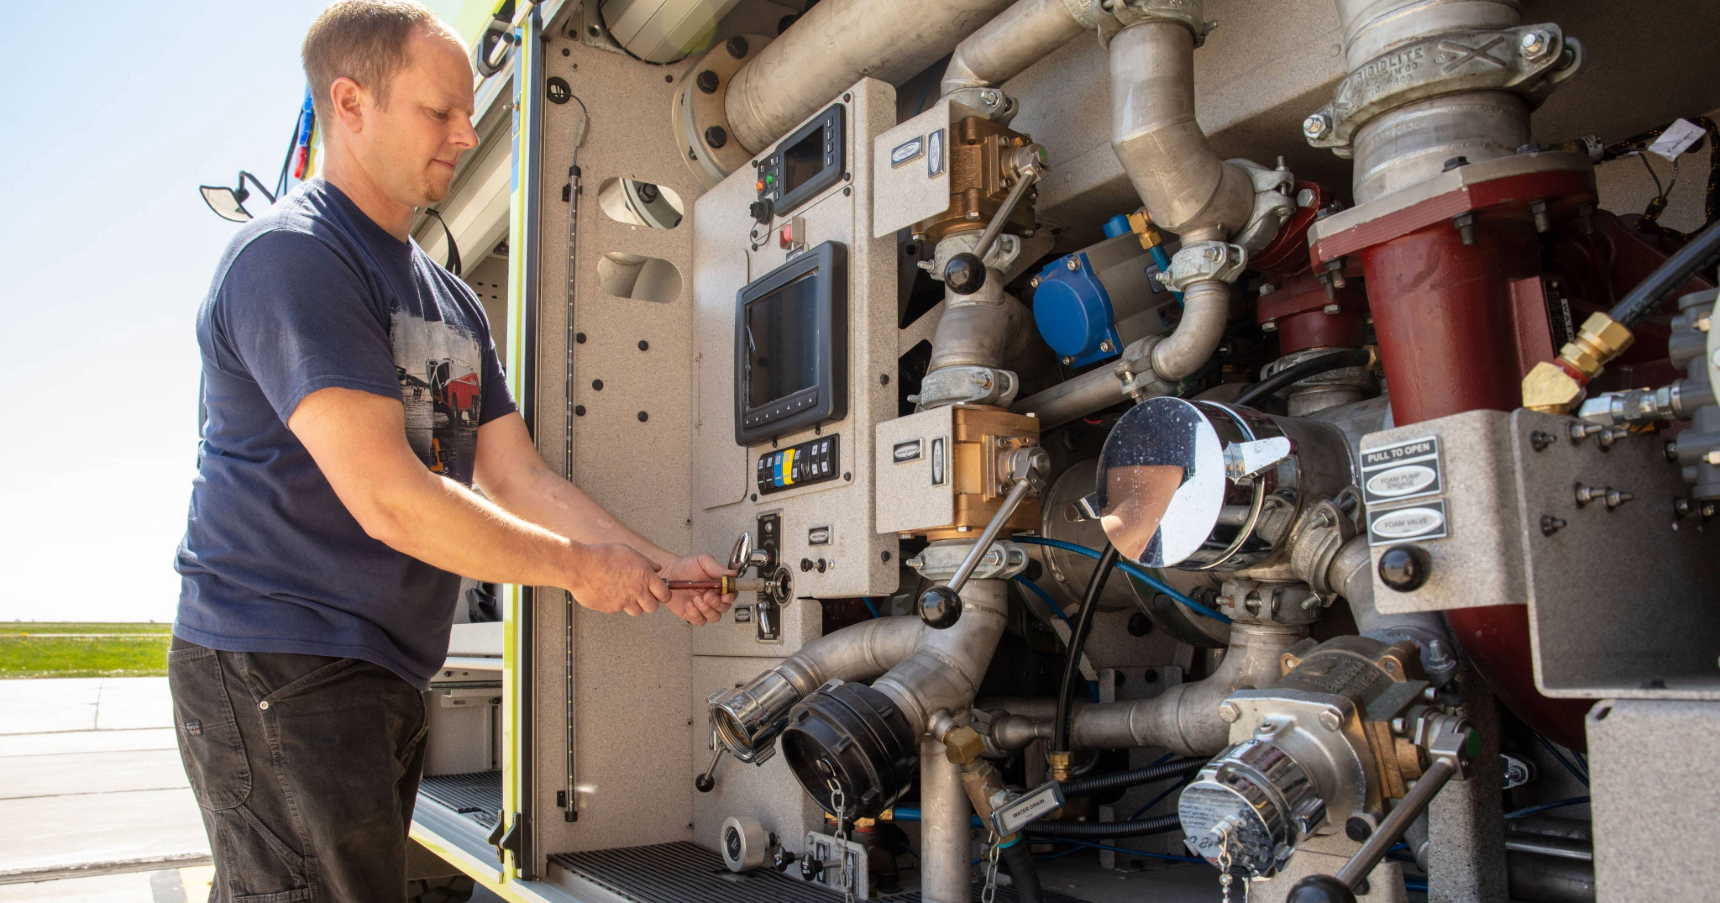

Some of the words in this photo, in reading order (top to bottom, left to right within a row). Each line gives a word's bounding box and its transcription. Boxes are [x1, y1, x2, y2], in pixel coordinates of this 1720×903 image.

[1367, 452, 1390, 463] PULL
[1390, 447, 1404, 458] TO
[1404, 442, 1431, 455] OPEN
[1380, 475, 1400, 484] FOAM
[1401, 472, 1420, 481] PUMP
[1387, 480, 1413, 490] ENGAGE
[1384, 519, 1405, 529] FOAM
[1406, 516, 1429, 526] VALVE
[1013, 806, 1029, 818] WATER
[1030, 798, 1045, 809] DRAIN
